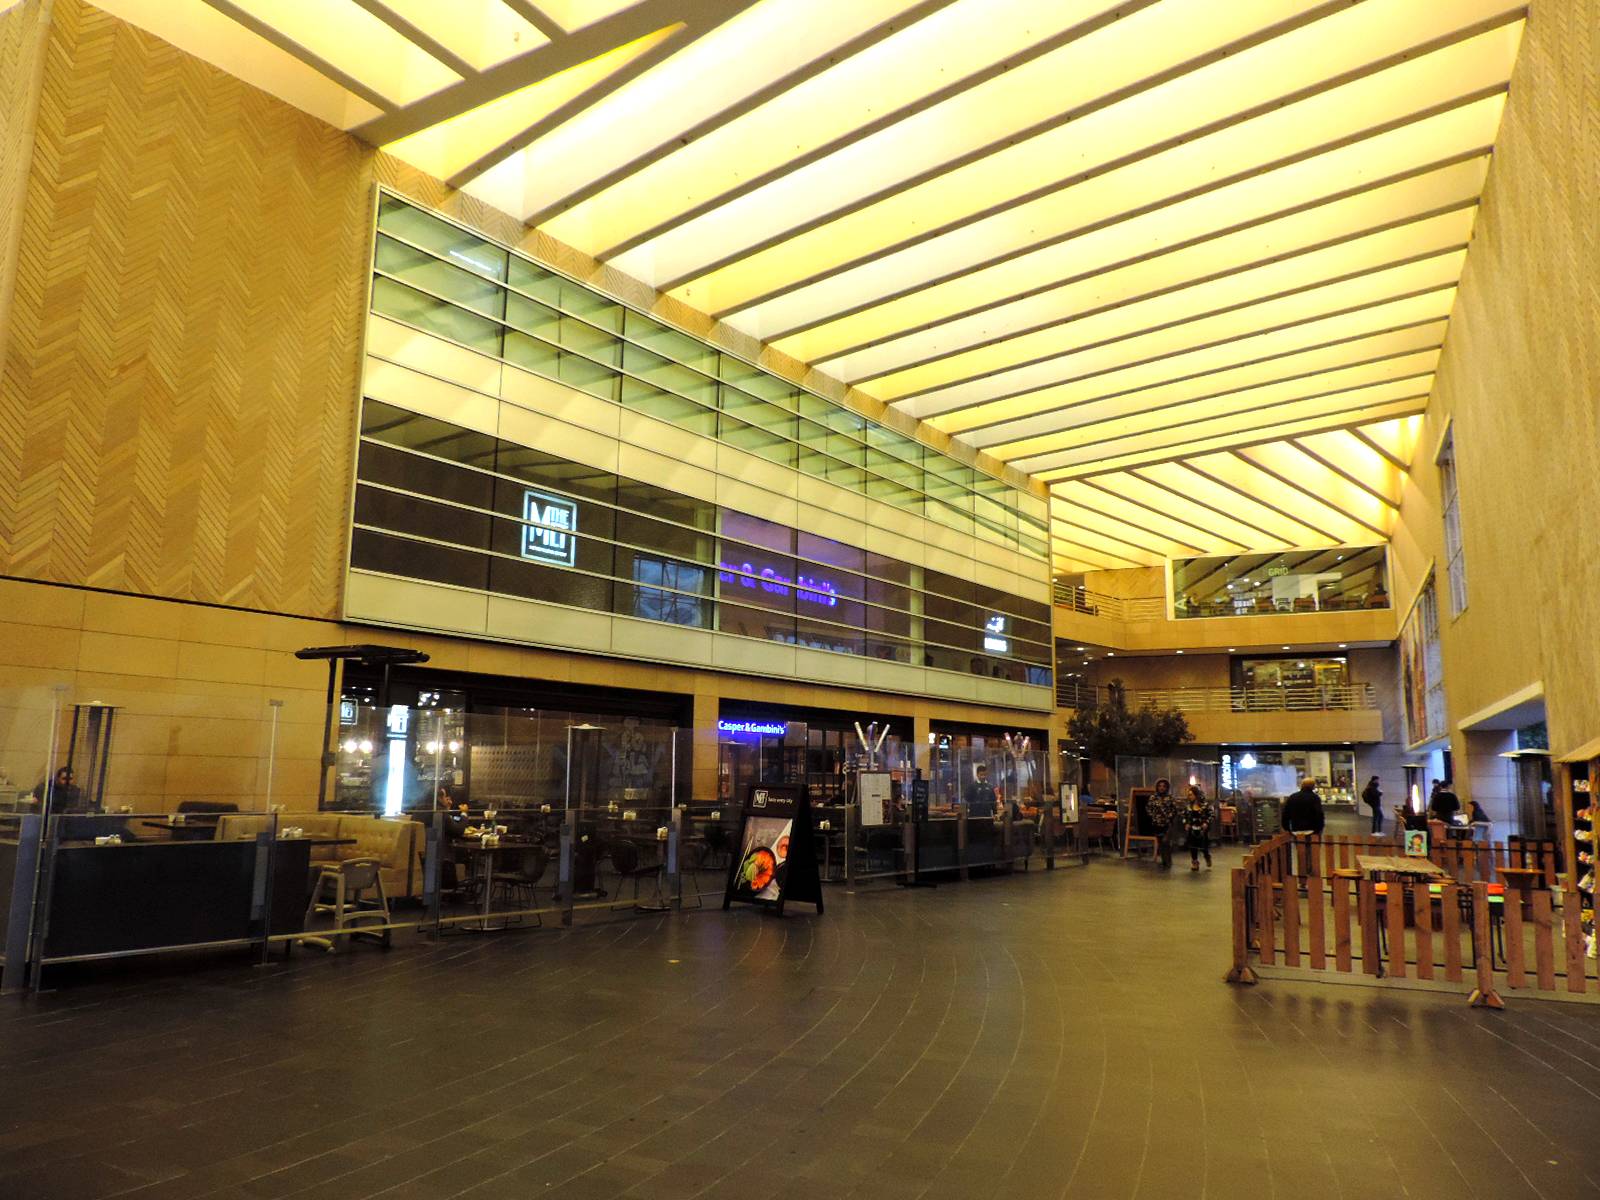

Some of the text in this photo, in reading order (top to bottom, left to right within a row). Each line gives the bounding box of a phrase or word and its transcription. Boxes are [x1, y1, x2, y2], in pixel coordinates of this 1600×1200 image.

[549, 506, 570, 521] THE
[718, 720, 785, 735] Casper & Gambini's
[1221, 754, 1233, 790] Antoine
